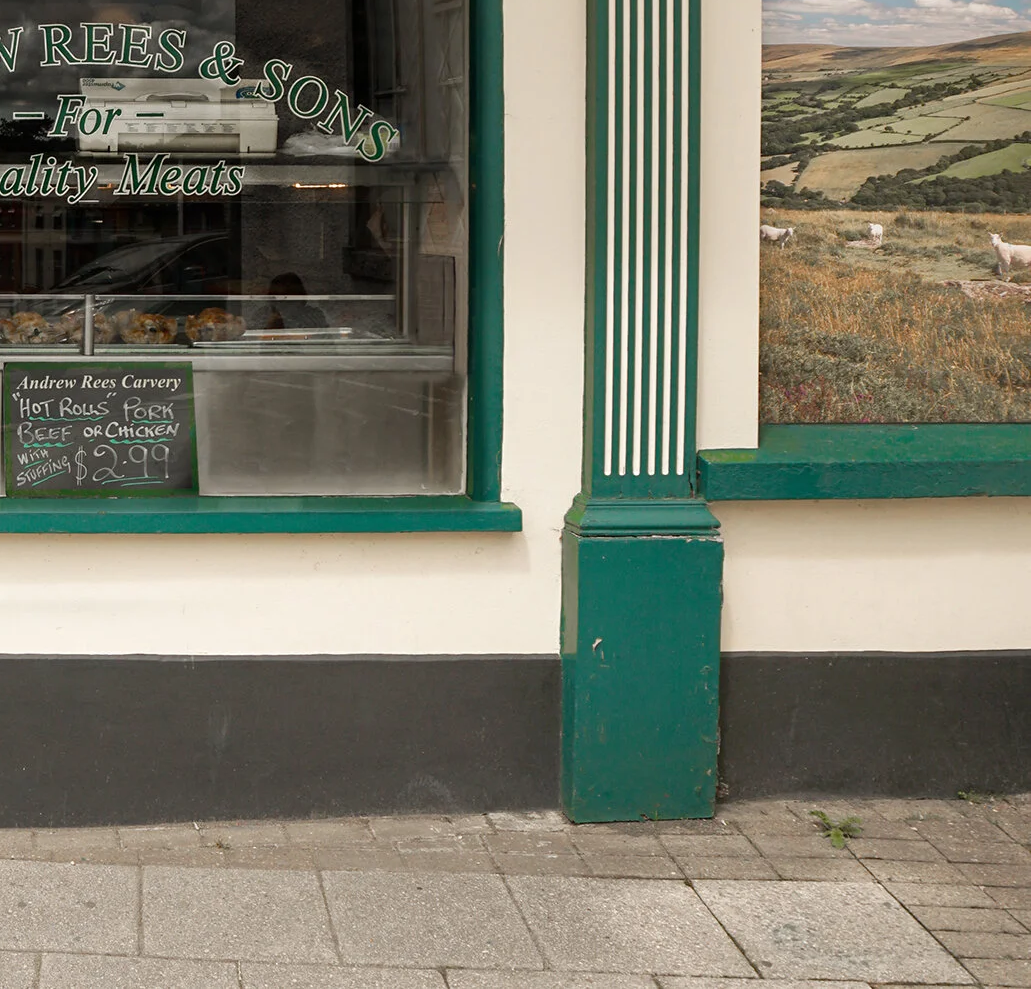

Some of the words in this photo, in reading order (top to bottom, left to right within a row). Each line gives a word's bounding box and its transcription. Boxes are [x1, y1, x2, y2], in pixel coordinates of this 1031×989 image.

[39, 22, 188, 73] REES
[199, 40, 245, 84] &
[253, 57, 401, 163] SONS
[47, 93, 123, 138] For
[112, 152, 245, 197] Meats
[16, 375, 77, 390] Andrew
[80, 374, 117, 389] Rees
[121, 374, 182, 392] Carvery
[123, 396, 175, 422] PORK
[17, 421, 73, 445] BEEF
